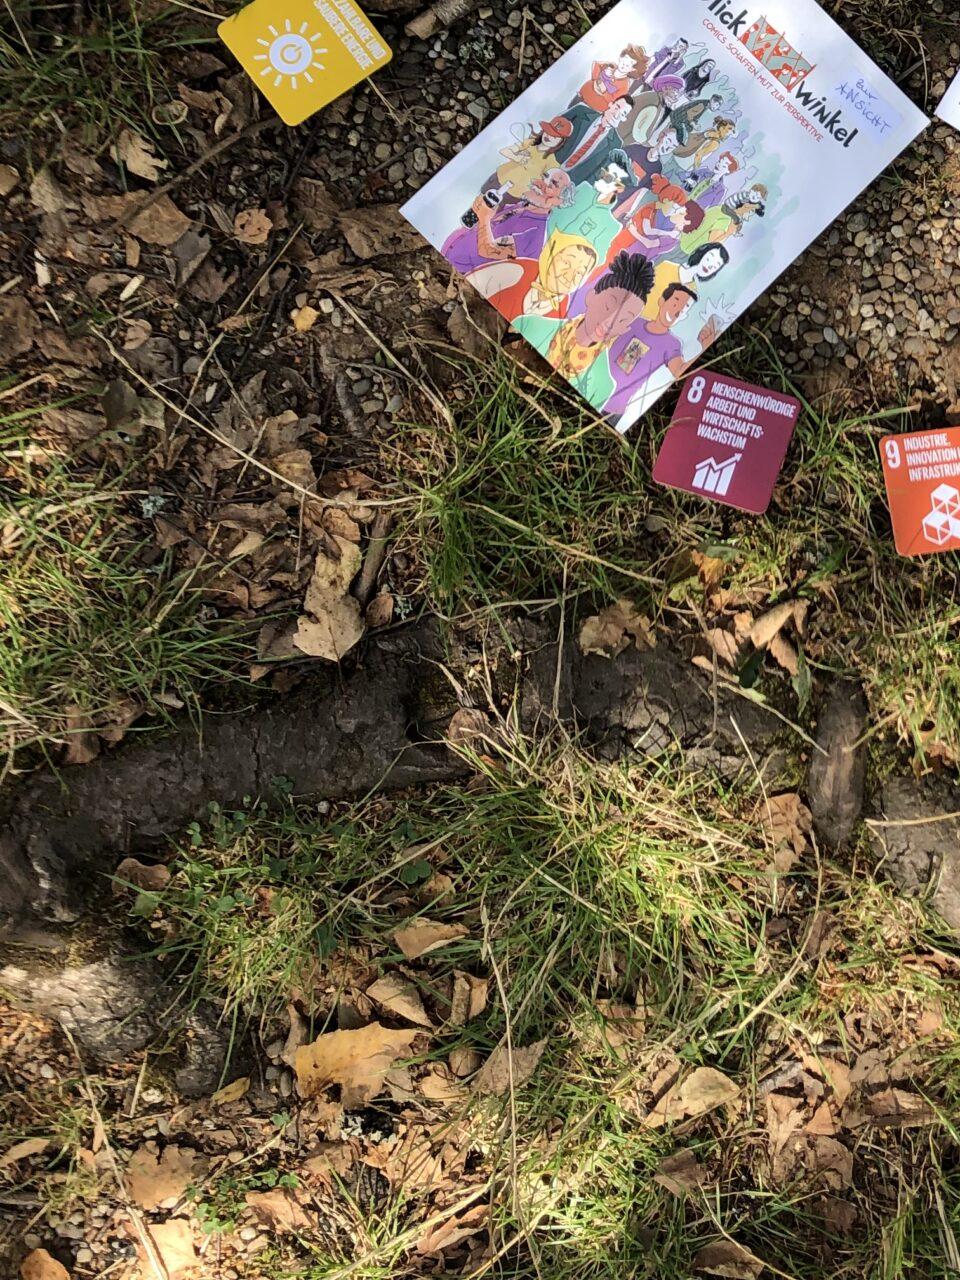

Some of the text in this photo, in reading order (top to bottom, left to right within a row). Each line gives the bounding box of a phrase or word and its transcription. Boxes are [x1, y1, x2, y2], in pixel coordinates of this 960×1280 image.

[341, 34, 373, 70] ENERGIE
[366, 39, 386, 59] UND
[702, 18, 824, 143] COMICS SCHAFFEN MUT ZUR PERSPEKTIVE
[687, 376, 706, 403] 8
[711, 381, 796, 418] MENSCHENWÜRDIGE
[706, 397, 756, 421] ARBEIT UND
[697, 424, 746, 449] WACHSTUM
[702, 409, 764, 438] WIRTSCHAFTS-
[885, 440, 901, 468] 9
[906, 448, 958, 465] INNOVATION
